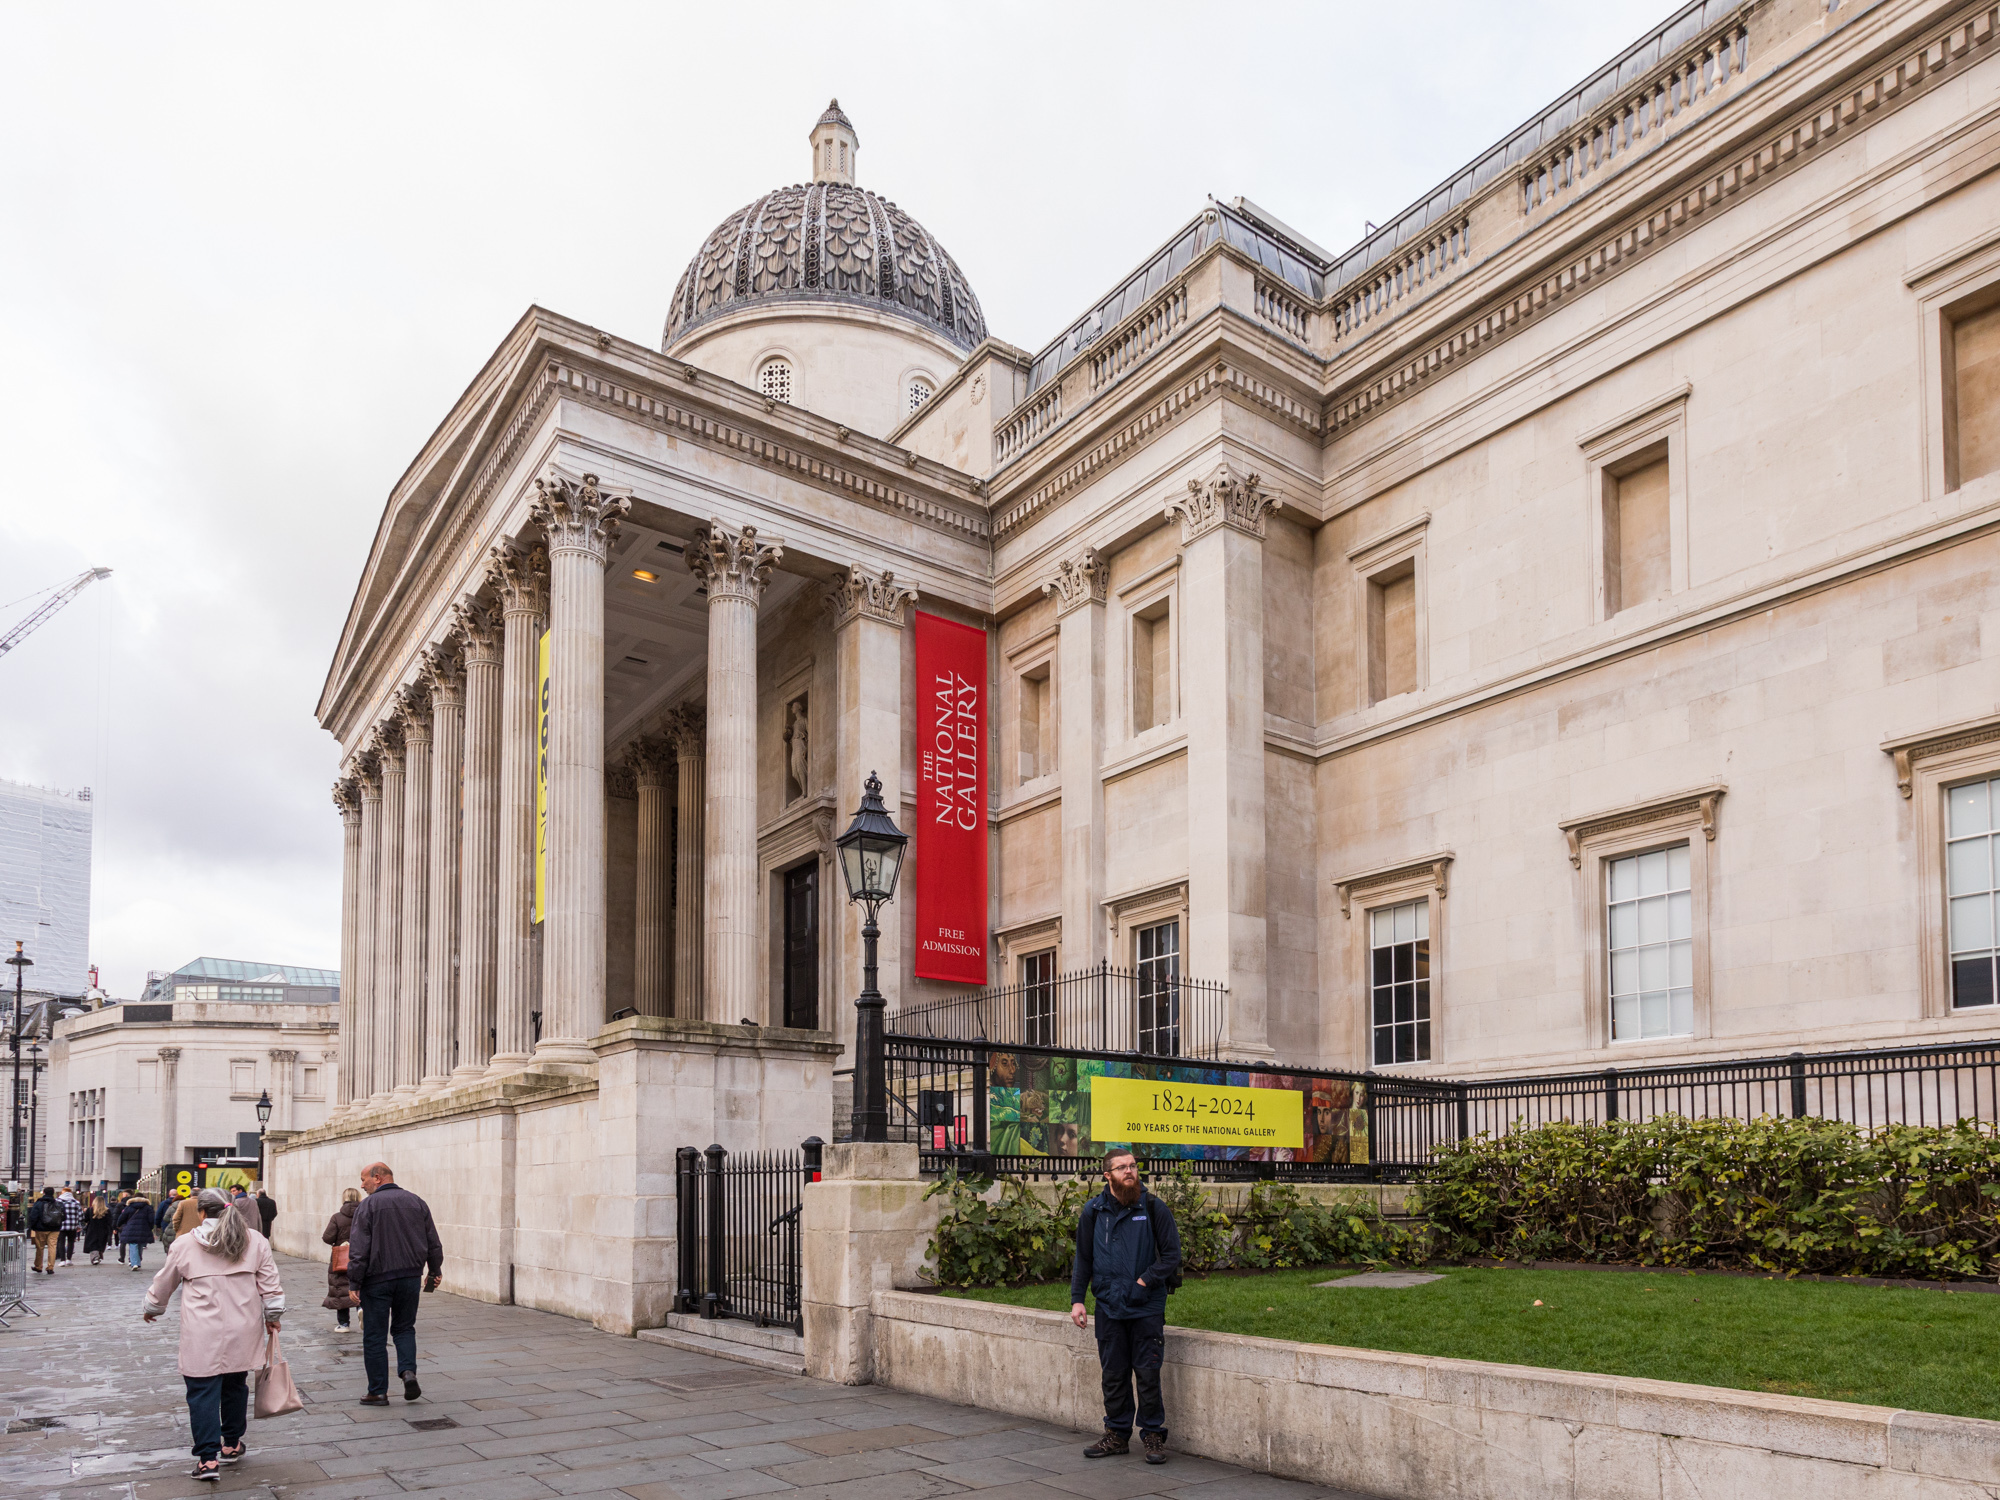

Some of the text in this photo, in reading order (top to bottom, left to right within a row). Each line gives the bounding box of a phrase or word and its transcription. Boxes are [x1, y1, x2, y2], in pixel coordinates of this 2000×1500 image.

[936, 670, 953, 827] NATIONAL
[957, 673, 977, 831] GALLERY
[923, 750, 933, 781] THE
[922, 940, 980, 956] ADMISSION
[938, 927, 965, 940] FREE
[1152, 1089, 1256, 1121] 1824-2024
[1126, 1122, 1276, 1137] 200 YEARS OF THE NATIONAL GALLERY
